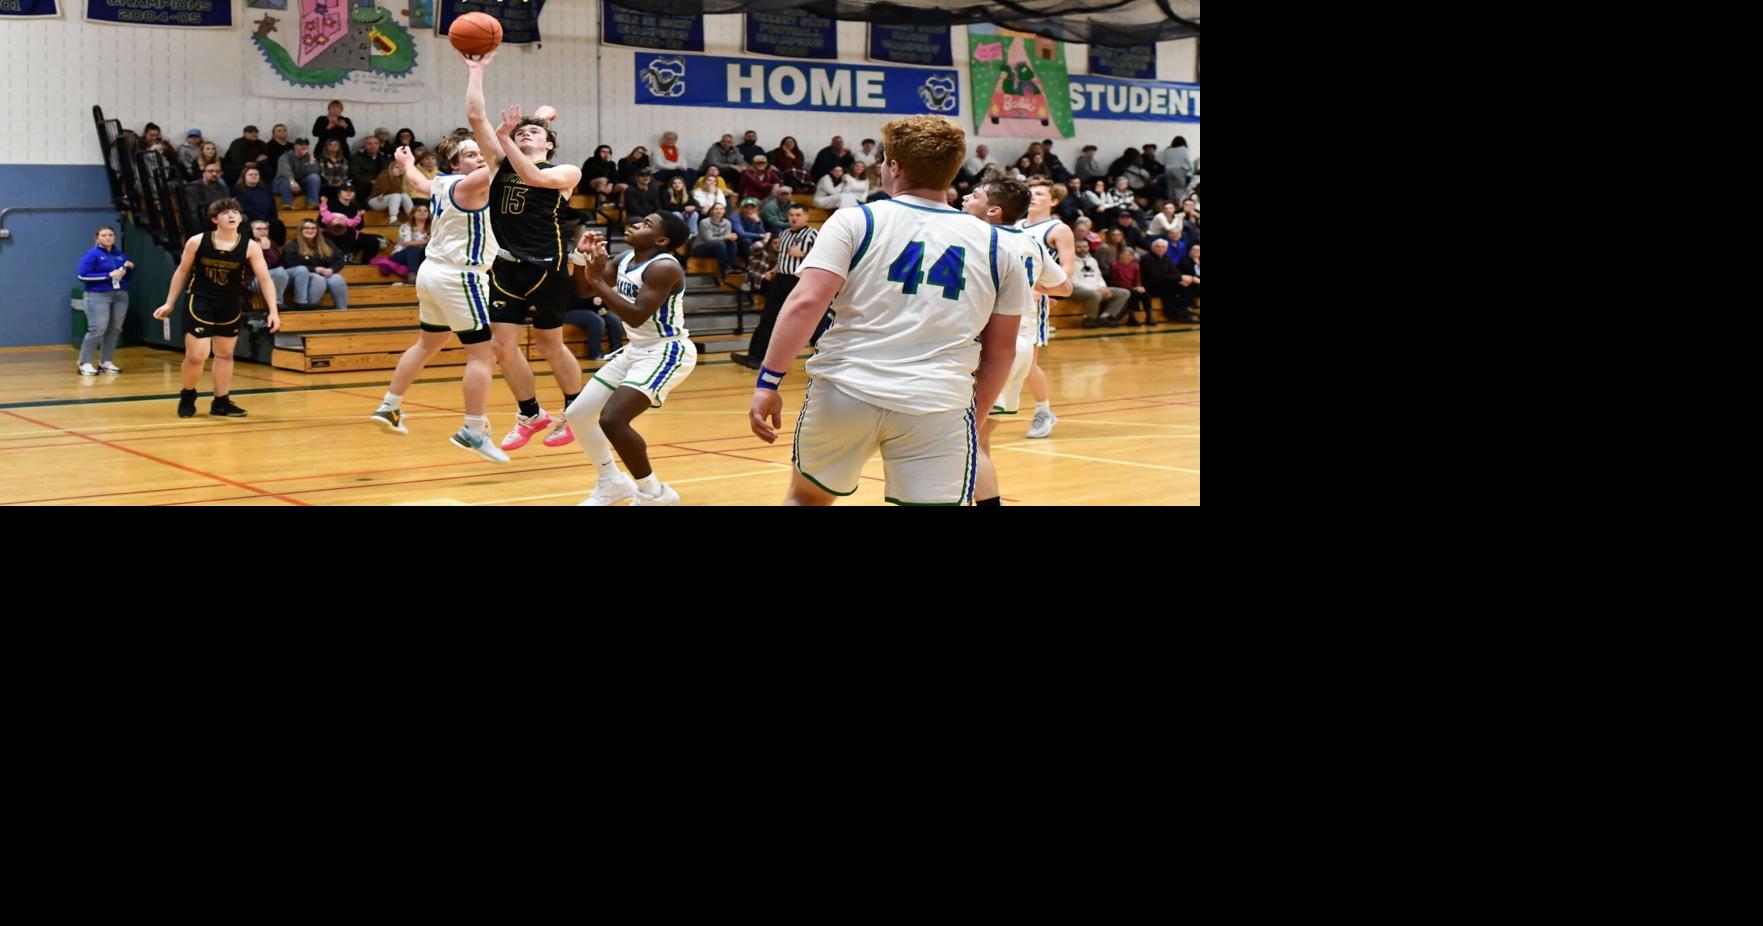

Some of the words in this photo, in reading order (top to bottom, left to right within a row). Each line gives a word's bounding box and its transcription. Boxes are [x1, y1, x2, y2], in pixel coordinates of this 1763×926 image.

[117, 8, 202, 24] 2004-05
[726, 63, 886, 108] HOME
[501, 185, 529, 215] 15
[886, 240, 966, 301] 44
[617, 279, 639, 298] KERS
